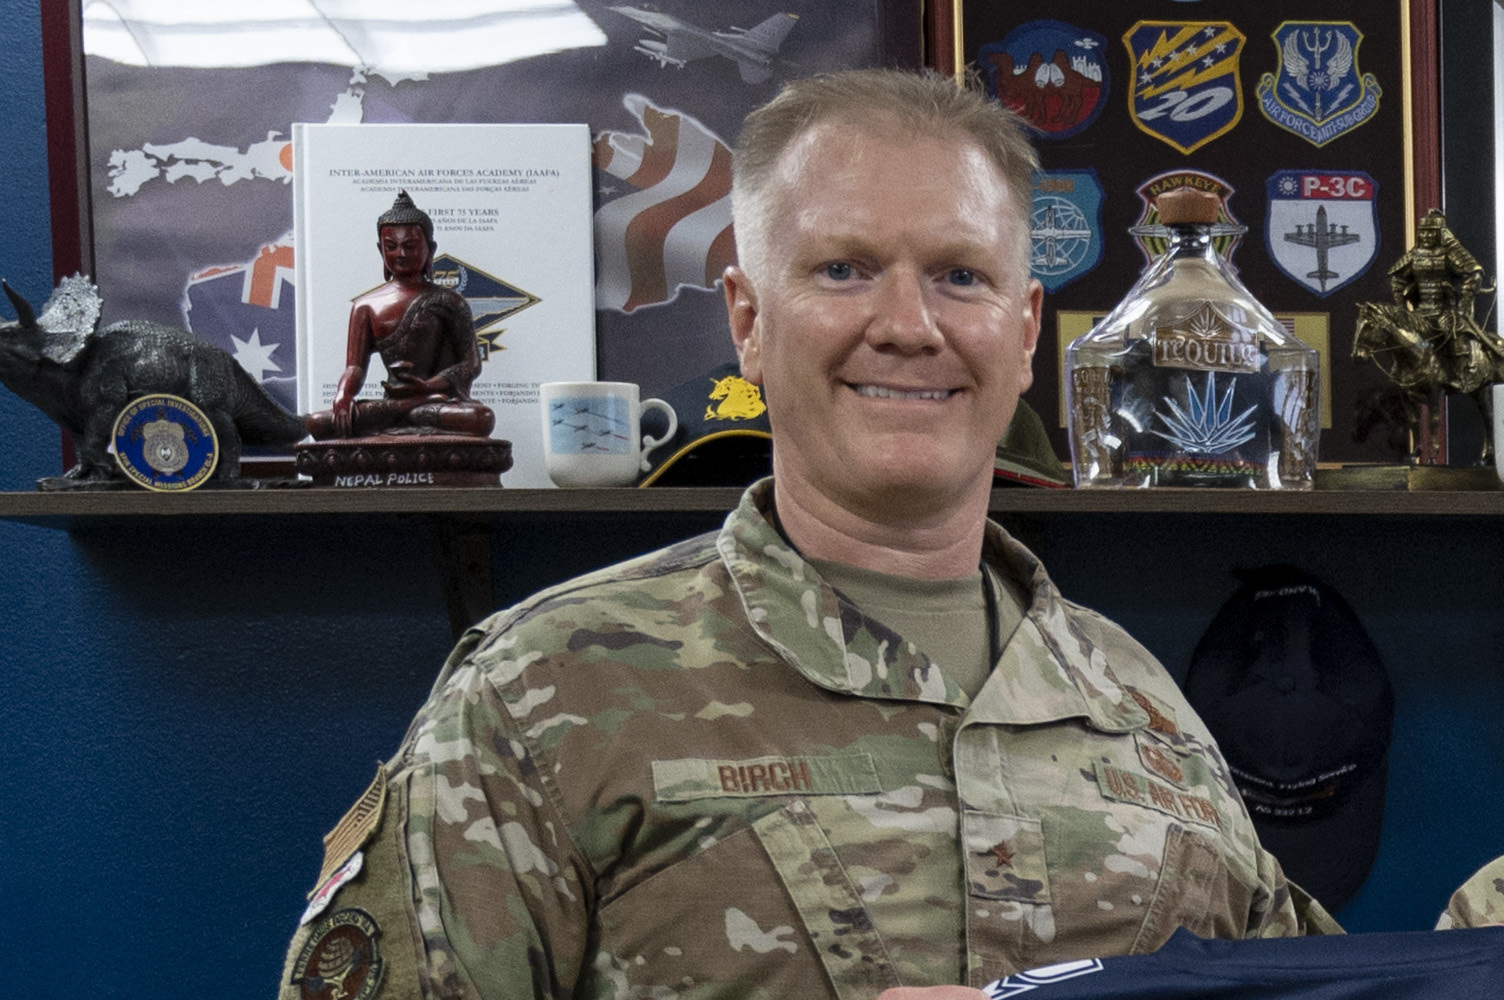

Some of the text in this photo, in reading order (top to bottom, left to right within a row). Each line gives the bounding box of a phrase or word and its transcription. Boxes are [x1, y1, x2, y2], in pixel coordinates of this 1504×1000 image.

[1138, 87, 1233, 121] 20
[1263, 97, 1279, 118] AIR
[1281, 111, 1318, 140] FORCE
[1353, 94, 1377, 122] GROUP
[329, 168, 560, 178] INTER-AMERICAN AIR FORCES ACADEMY (IAAFA)
[1150, 176, 1221, 195] HAWKEYE
[1303, 177, 1366, 197] P-3C
[428, 208, 455, 216] FIRST
[468, 208, 499, 216] YEARS
[138, 399, 165, 410] SPECIAL
[335, 472, 434, 487] NEPAL POLICE
[718, 762, 812, 793] BIRCH
[1148, 780, 1181, 816] AIR
[1177, 794, 1224, 830] FOR
